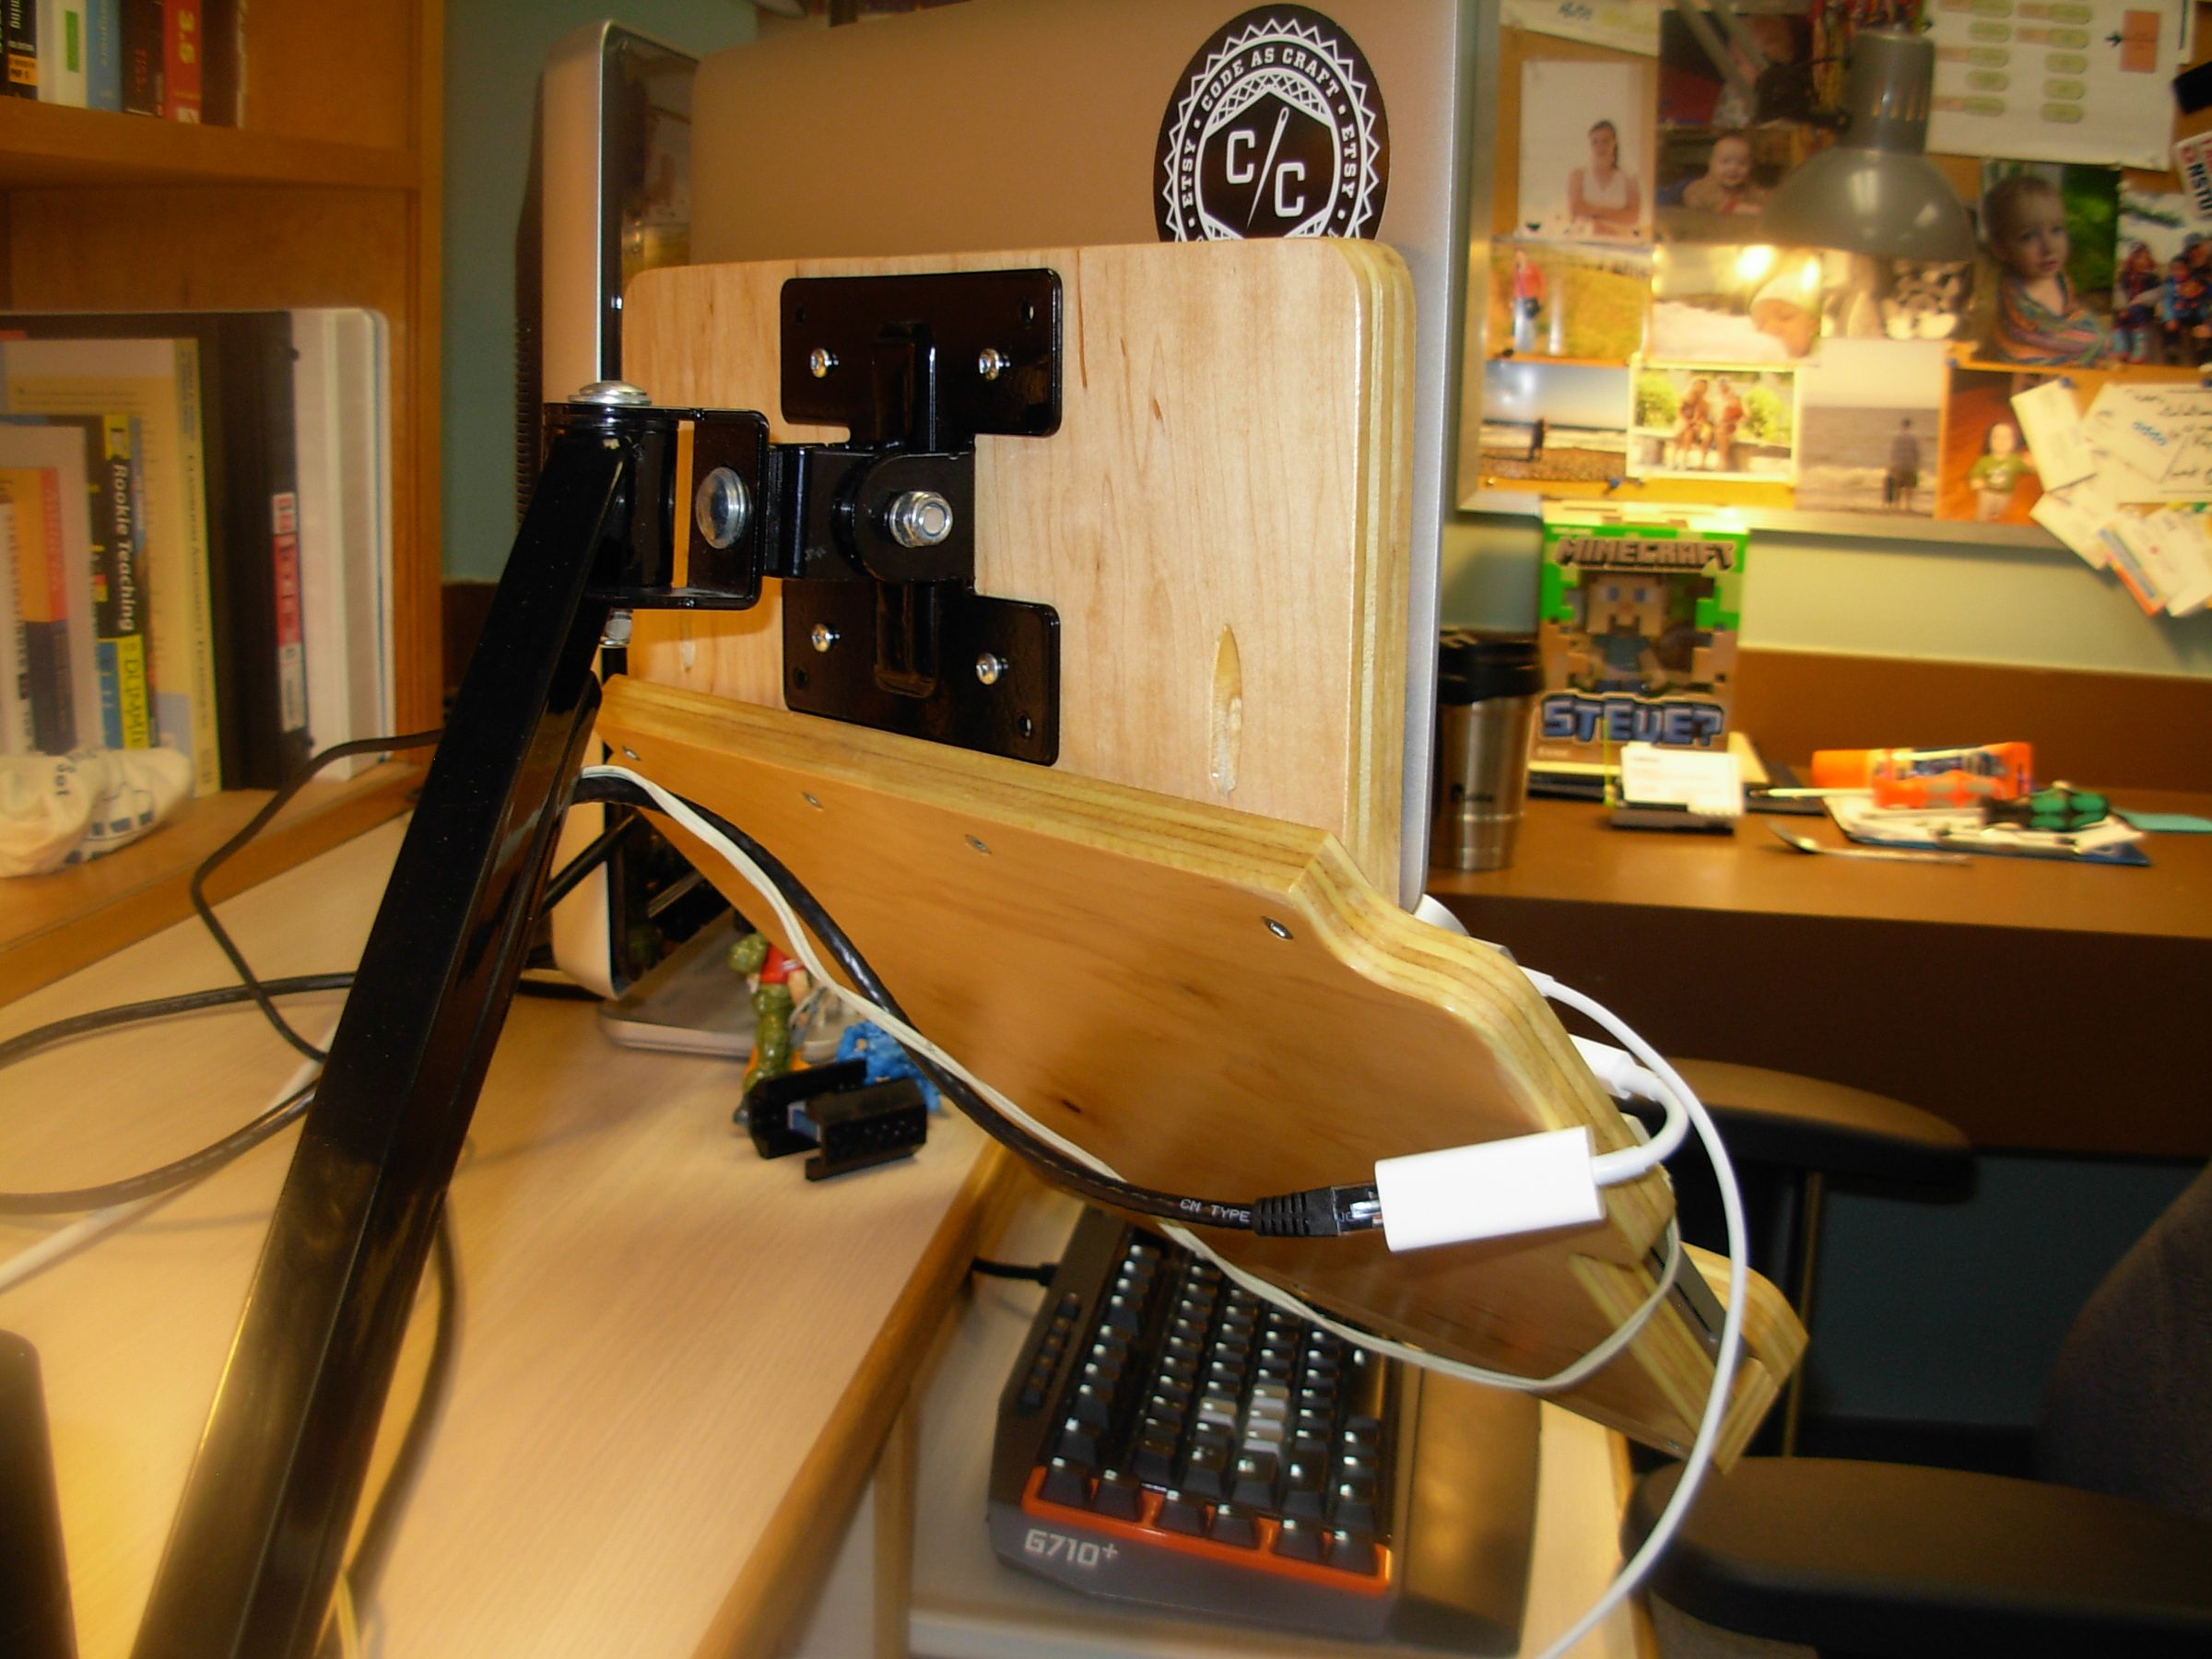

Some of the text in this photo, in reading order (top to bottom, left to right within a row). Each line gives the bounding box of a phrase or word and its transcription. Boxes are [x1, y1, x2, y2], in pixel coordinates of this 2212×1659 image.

[1201, 48, 1339, 112] CODE AS CRAFT
[1182, 138, 1196, 207] ETSY
[1340, 124, 1359, 200] ETSY
[112, 463, 132, 536] Rookie
[117, 540, 135, 632] Teaching
[1555, 537, 1735, 571] MINECRAFT
[1211, 1204, 1251, 1224] TYPE
[1023, 1527, 1119, 1567] G710+
